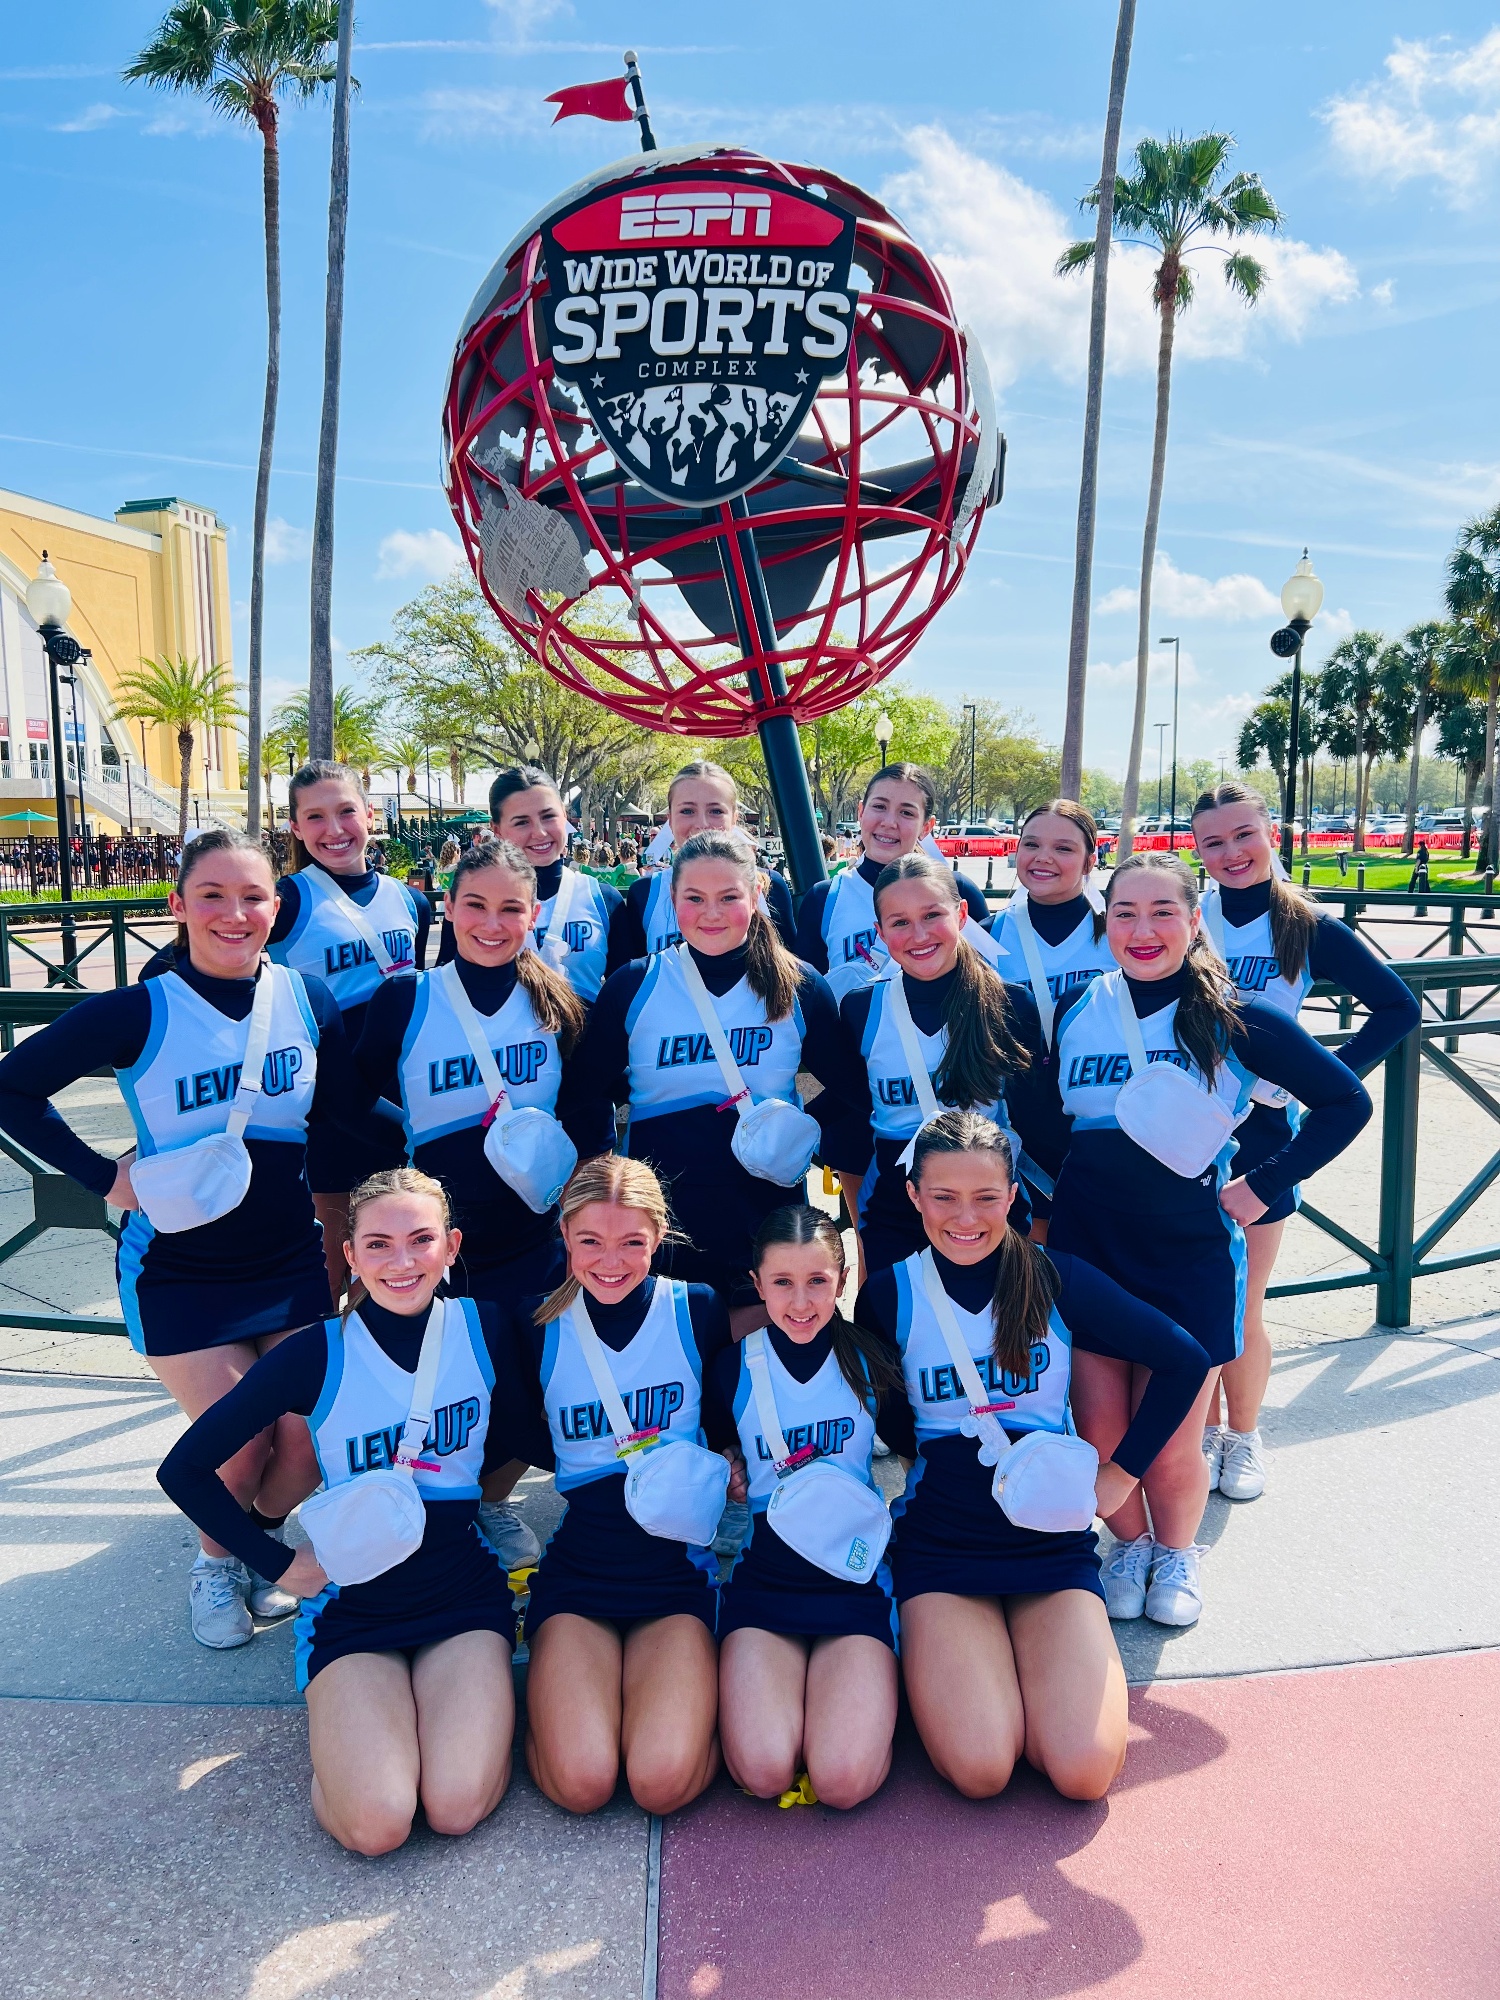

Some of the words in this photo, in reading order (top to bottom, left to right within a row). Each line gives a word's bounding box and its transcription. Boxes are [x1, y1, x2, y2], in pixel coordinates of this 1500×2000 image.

[619, 192, 771, 241] ESPN
[563, 255, 658, 293] WIDE
[664, 249, 792, 285] WORLD
[797, 260, 834, 288] OF
[552, 288, 851, 365] SPORTS
[638, 360, 758, 378] COMPLEX
[494, 525, 519, 574] DRIVE
[324, 934, 384, 977] LEVE
[382, 928, 412, 964] UP
[1236, 956, 1281, 991] UP
[262, 1046, 302, 1097] UP
[429, 1047, 508, 1096] LEVL
[506, 1040, 547, 1086] UP
[656, 1030, 729, 1070] LEVE
[730, 1026, 773, 1068] UP
[434, 1396, 480, 1456] UP
[559, 1391, 639, 1442] LEVL
[635, 1381, 684, 1432] UP
[755, 1423, 819, 1461] LVEL
[815, 1417, 855, 1457] UP
